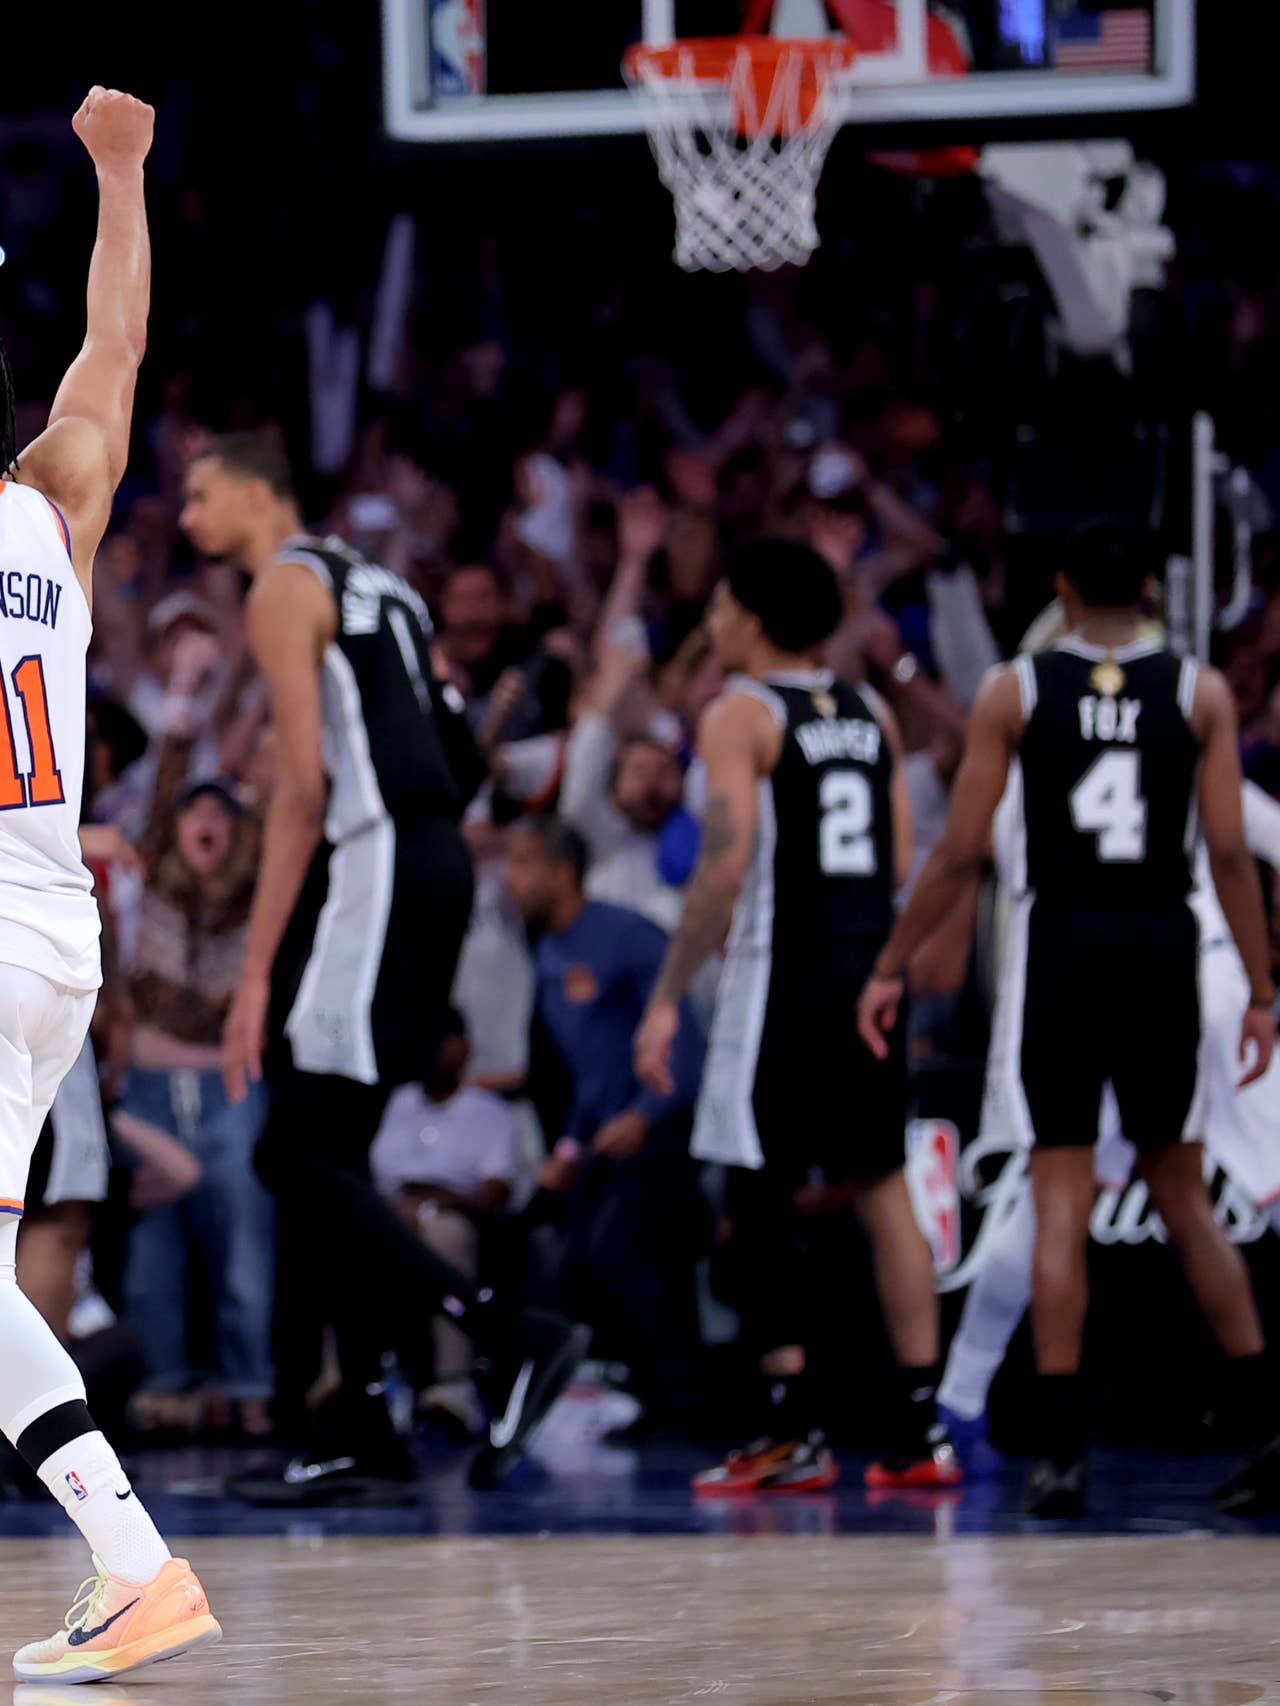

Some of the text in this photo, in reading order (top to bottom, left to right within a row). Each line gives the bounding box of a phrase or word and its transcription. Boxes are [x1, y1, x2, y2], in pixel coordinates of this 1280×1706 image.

[1078, 696, 1141, 743] FOX
[818, 768, 877, 877] 2
[1069, 748, 1147, 864] 4
